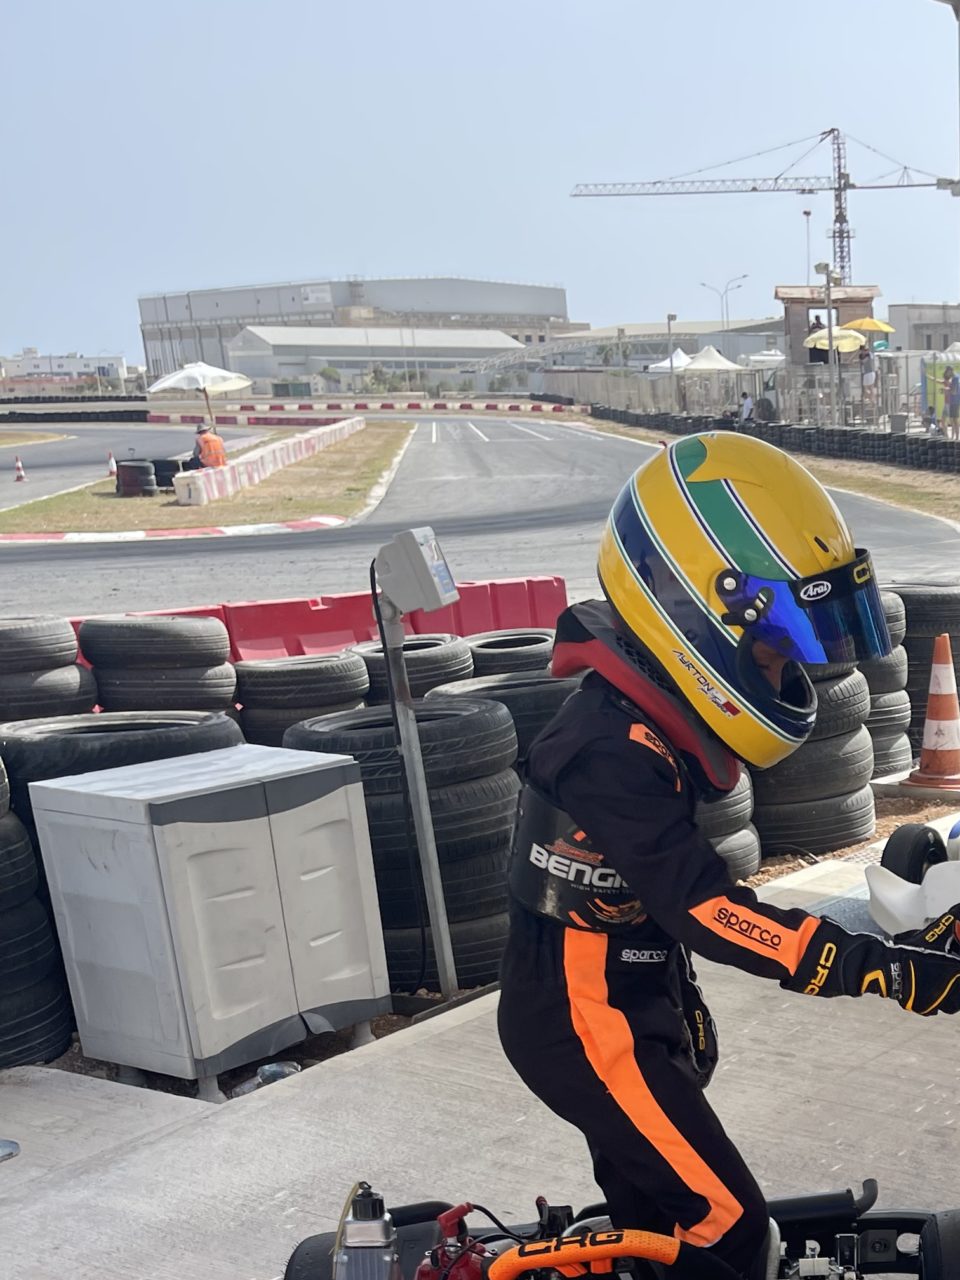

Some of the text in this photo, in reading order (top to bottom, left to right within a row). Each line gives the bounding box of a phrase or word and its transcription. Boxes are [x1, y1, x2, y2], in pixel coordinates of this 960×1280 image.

[714, 905, 782, 951] sparco
[925, 914, 954, 943] CRG
[620, 948, 668, 963] sparco
[804, 942, 837, 996] CRG
[518, 1230, 625, 1258] CRG
